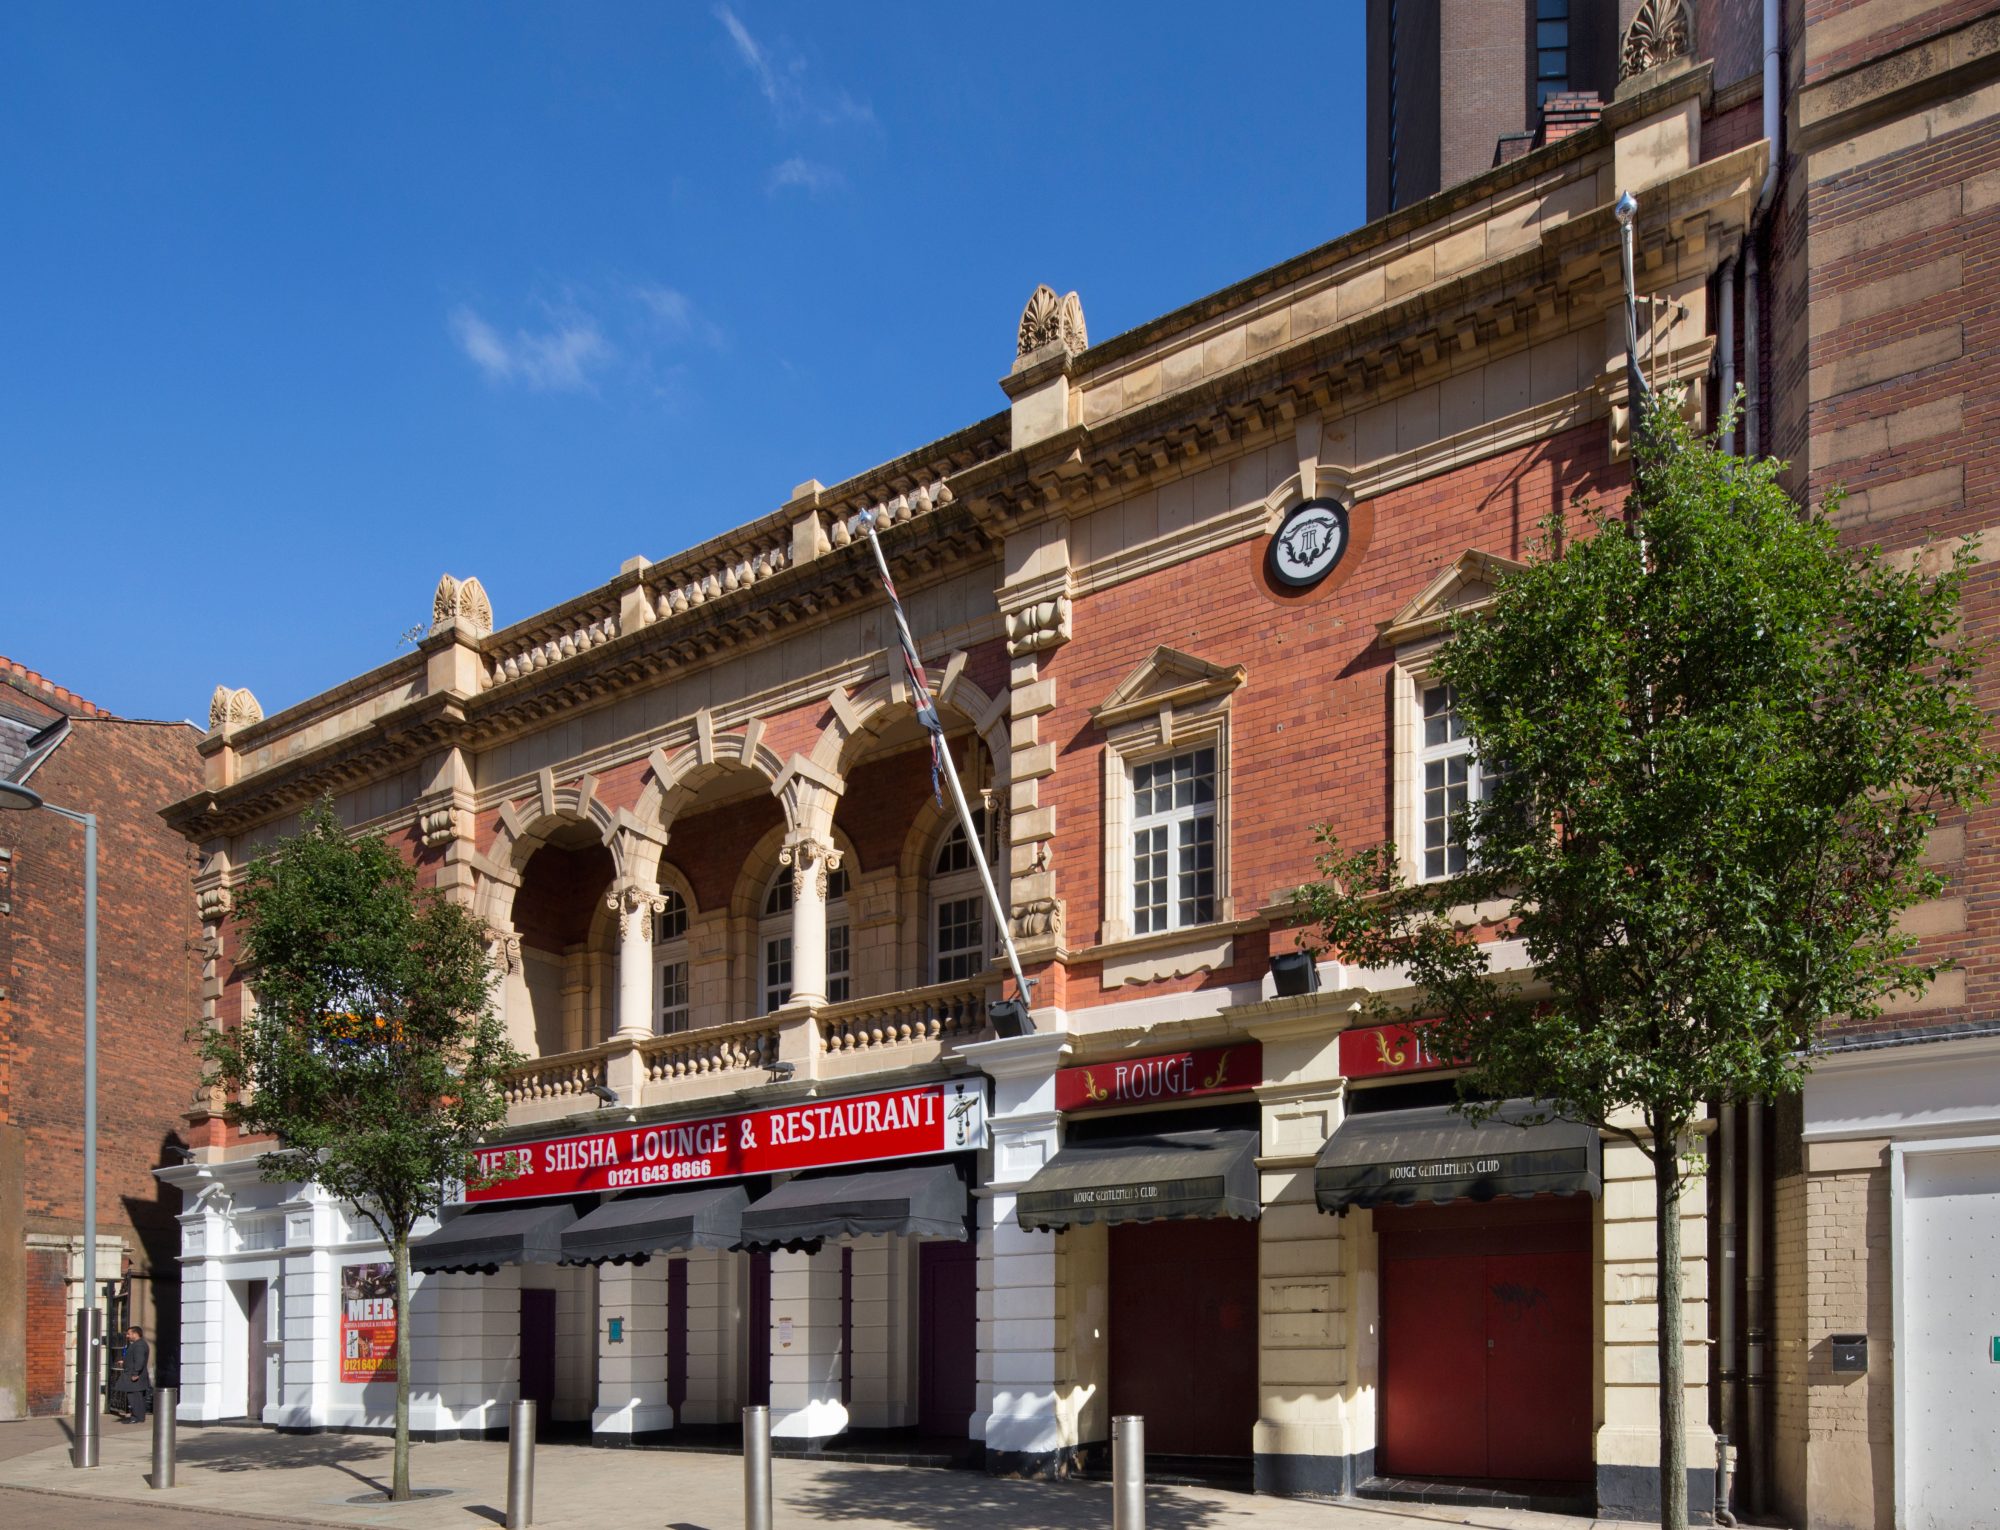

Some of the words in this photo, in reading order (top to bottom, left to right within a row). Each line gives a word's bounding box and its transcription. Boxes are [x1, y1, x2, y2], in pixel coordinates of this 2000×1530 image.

[1115, 1057, 1195, 1100] ROUGE
[545, 1137, 619, 1173] SHISHA
[631, 1122, 727, 1163] LOUNGE
[740, 1119, 757, 1150] &
[770, 1092, 940, 1145] RESTAURANT
[608, 1168, 639, 1186] 0121
[641, 1164, 669, 1183] 643
[672, 1159, 712, 1179] 8866
[1389, 1166, 1416, 1179] ROUGE
[1477, 1160, 1500, 1173] CLUB
[1073, 1191, 1095, 1203] ROUGE
[1140, 1186, 1158, 1198] CLUB
[348, 1298, 394, 1321] MEER
[344, 1359, 360, 1371] 0121
[361, 1359, 377, 1371] 643
